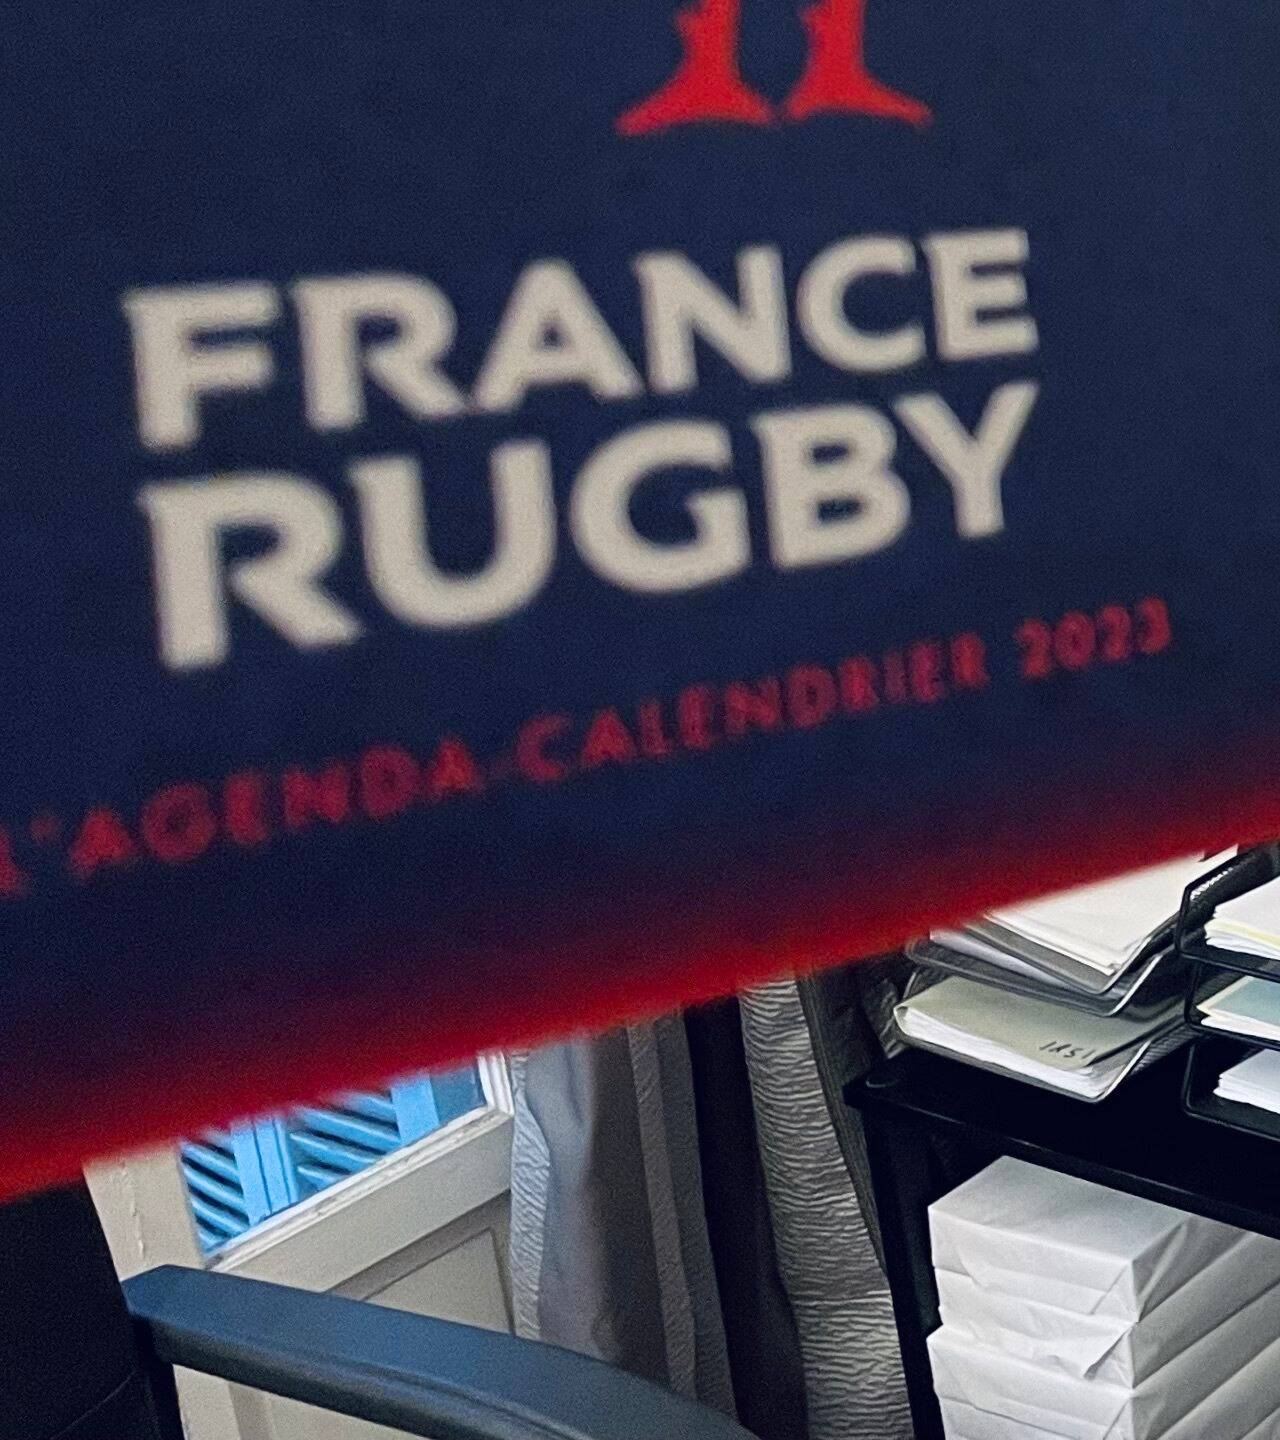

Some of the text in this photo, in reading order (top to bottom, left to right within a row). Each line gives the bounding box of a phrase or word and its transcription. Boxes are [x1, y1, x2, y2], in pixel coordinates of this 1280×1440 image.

[122, 228, 1038, 452] FRANCE
[137, 381, 1038, 673] RUGBY
[1013, 595, 1173, 682] 2023
